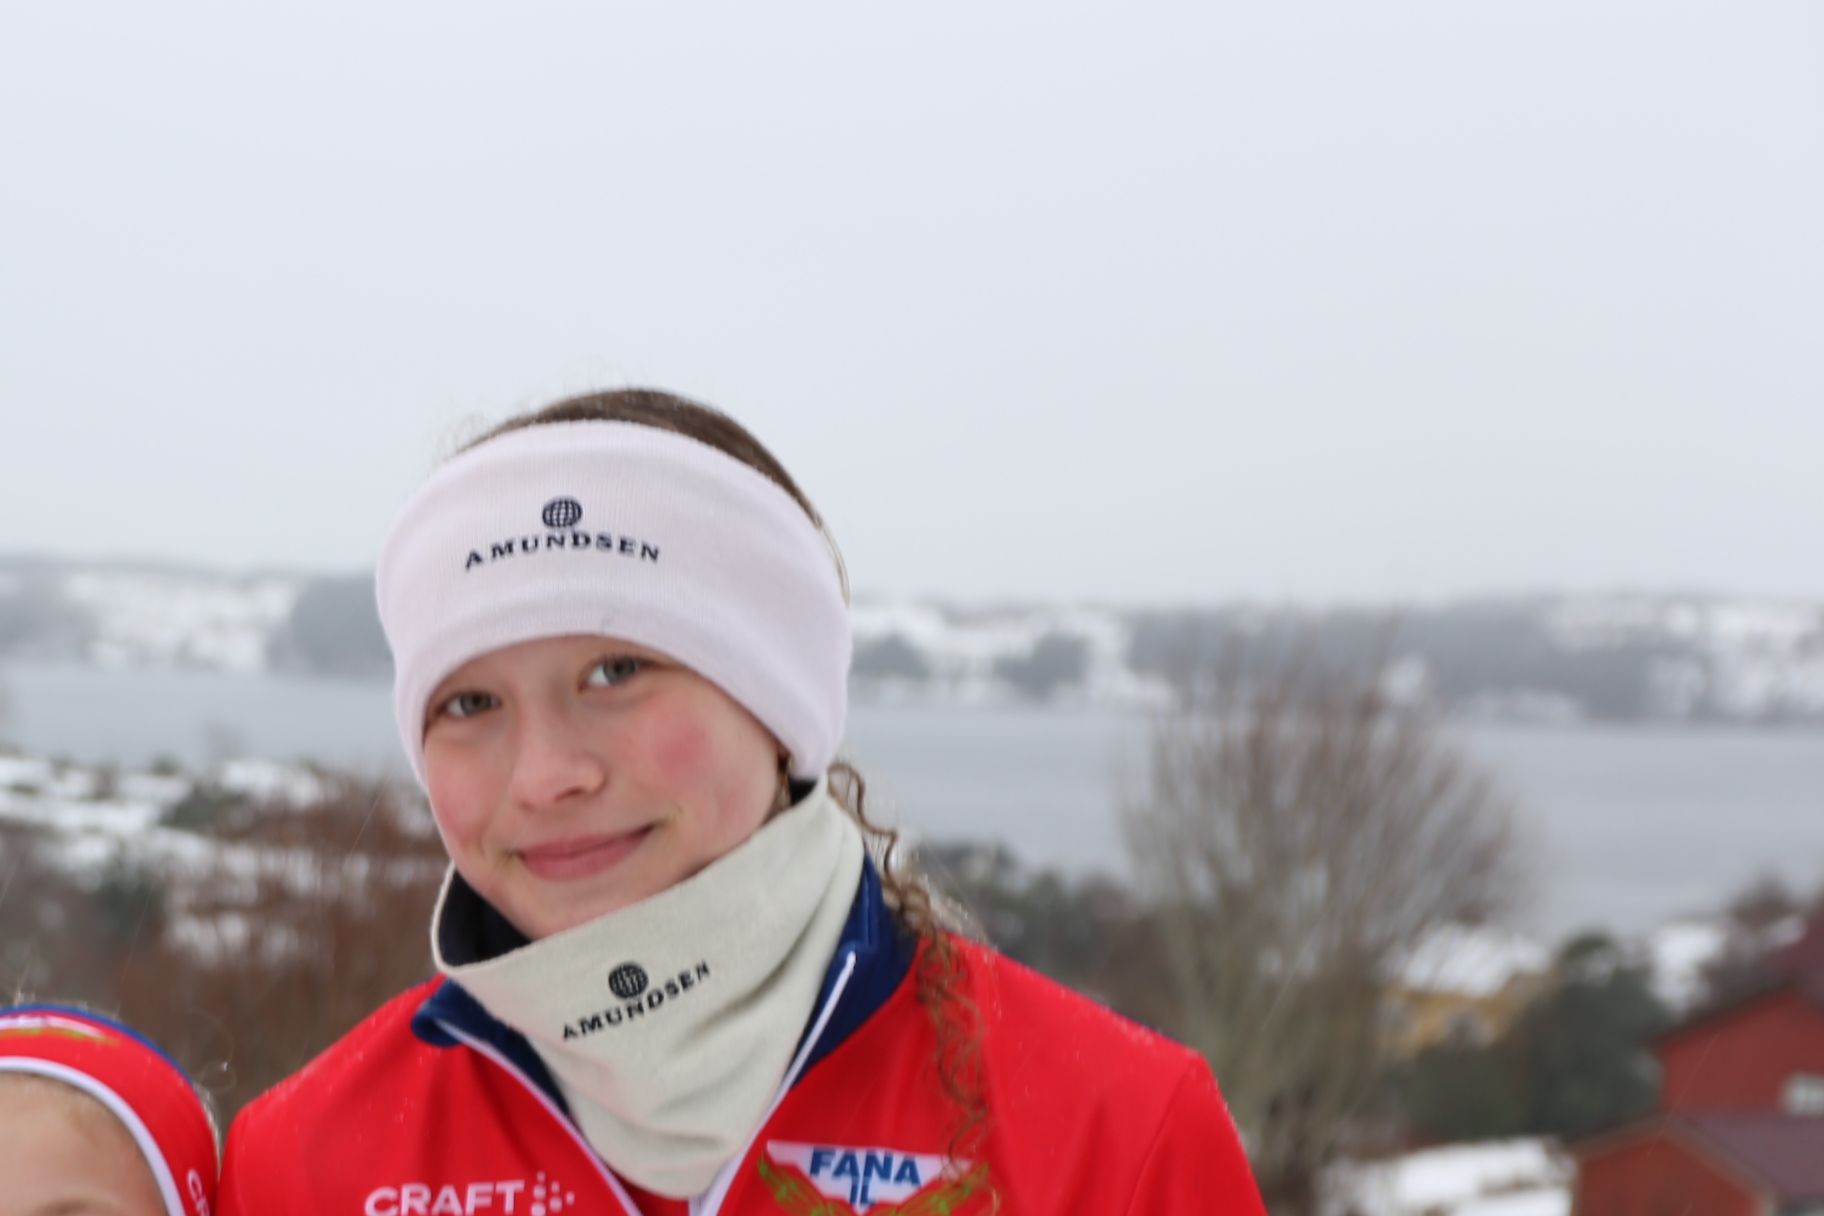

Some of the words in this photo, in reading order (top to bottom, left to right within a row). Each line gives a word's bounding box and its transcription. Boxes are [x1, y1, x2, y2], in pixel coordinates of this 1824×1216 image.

[464, 530, 660, 572] AMUNDSEN
[562, 960, 711, 1041] AMUNDSEN
[809, 1147, 922, 1187] FANA
